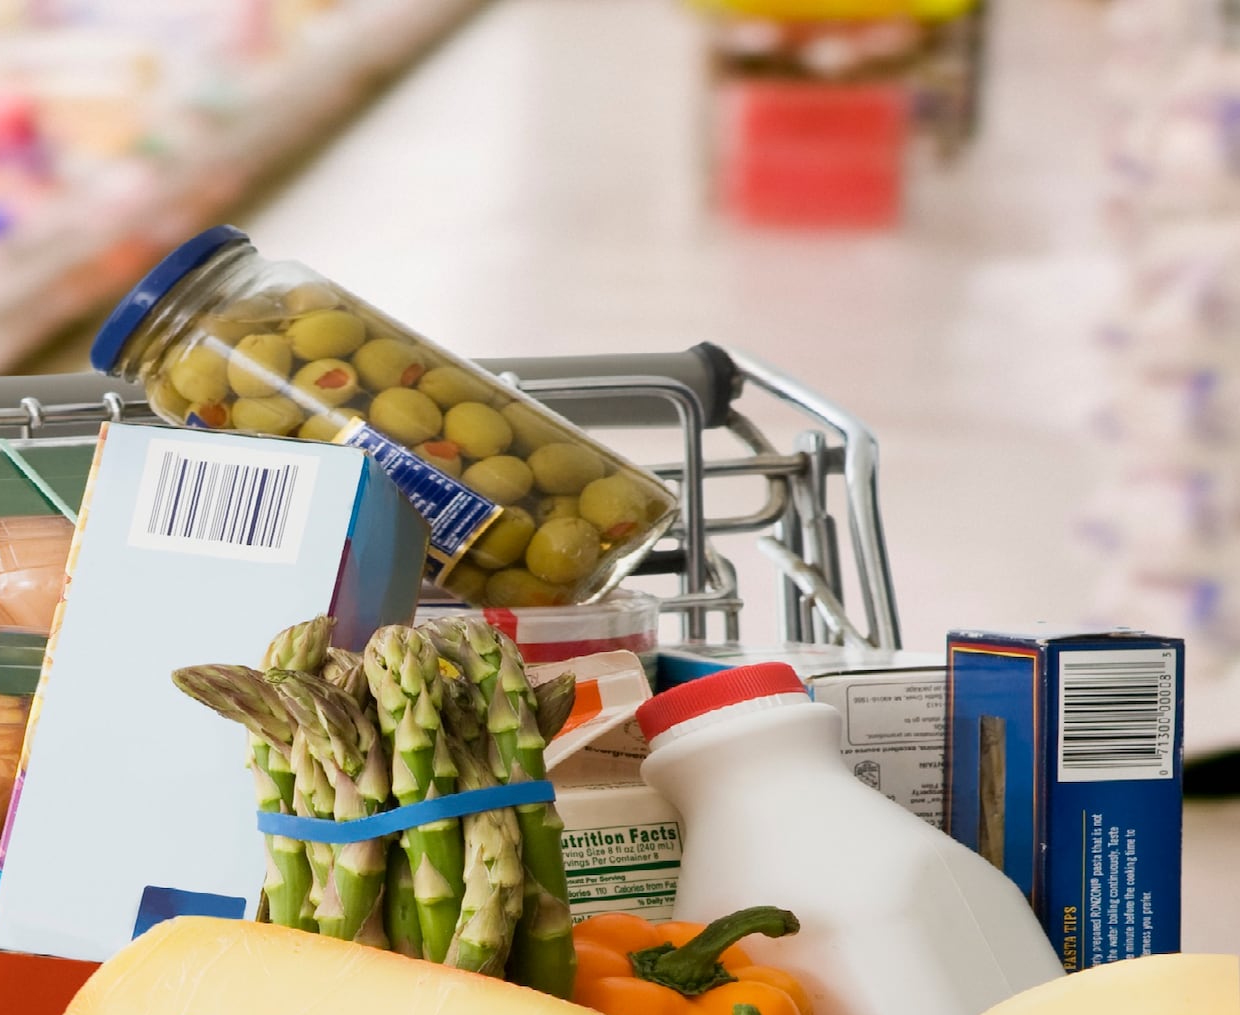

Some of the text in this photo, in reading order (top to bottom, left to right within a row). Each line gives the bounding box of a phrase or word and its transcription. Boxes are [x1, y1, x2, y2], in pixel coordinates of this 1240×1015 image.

[855, 747, 881, 755] source
[882, 745, 917, 753] excellent
[1091, 813, 1103, 826] not
[562, 825, 678, 850] utrition Facts
[1091, 828, 1102, 836] is
[1125, 829, 1136, 837] to
[563, 848, 585, 859] rving
[586, 846, 606, 858] Size
[608, 846, 614, 855] 8
[624, 845, 634, 855] oz
[1091, 837, 1103, 853] that
[1124, 839, 1136, 855] time
[564, 857, 590, 869] rvings
[592, 856, 607, 866] Per
[609, 852, 653, 864] Container
[1092, 854, 1104, 876] pasta
[585, 876, 598, 884] Per
[599, 874, 626, 884] Serving
[1124, 857, 1138, 886] cooking
[568, 888, 591, 899] lories
[595, 886, 608, 896] 110
[613, 883, 646, 895] Calories
[646, 882, 663, 892] from
[1107, 826, 1120, 961] the water boiling continuously. Taste
[1124, 887, 1135, 900] the
[646, 896, 663, 907] Daily
[1124, 901, 1135, 925] before
[1142, 917, 1154, 930] you
[1063, 906, 1077, 970] PASTA TIPS
[1090, 919, 1103, 952] prepared
[1124, 926, 1135, 952] minute
[1141, 931, 1152, 954] erness
